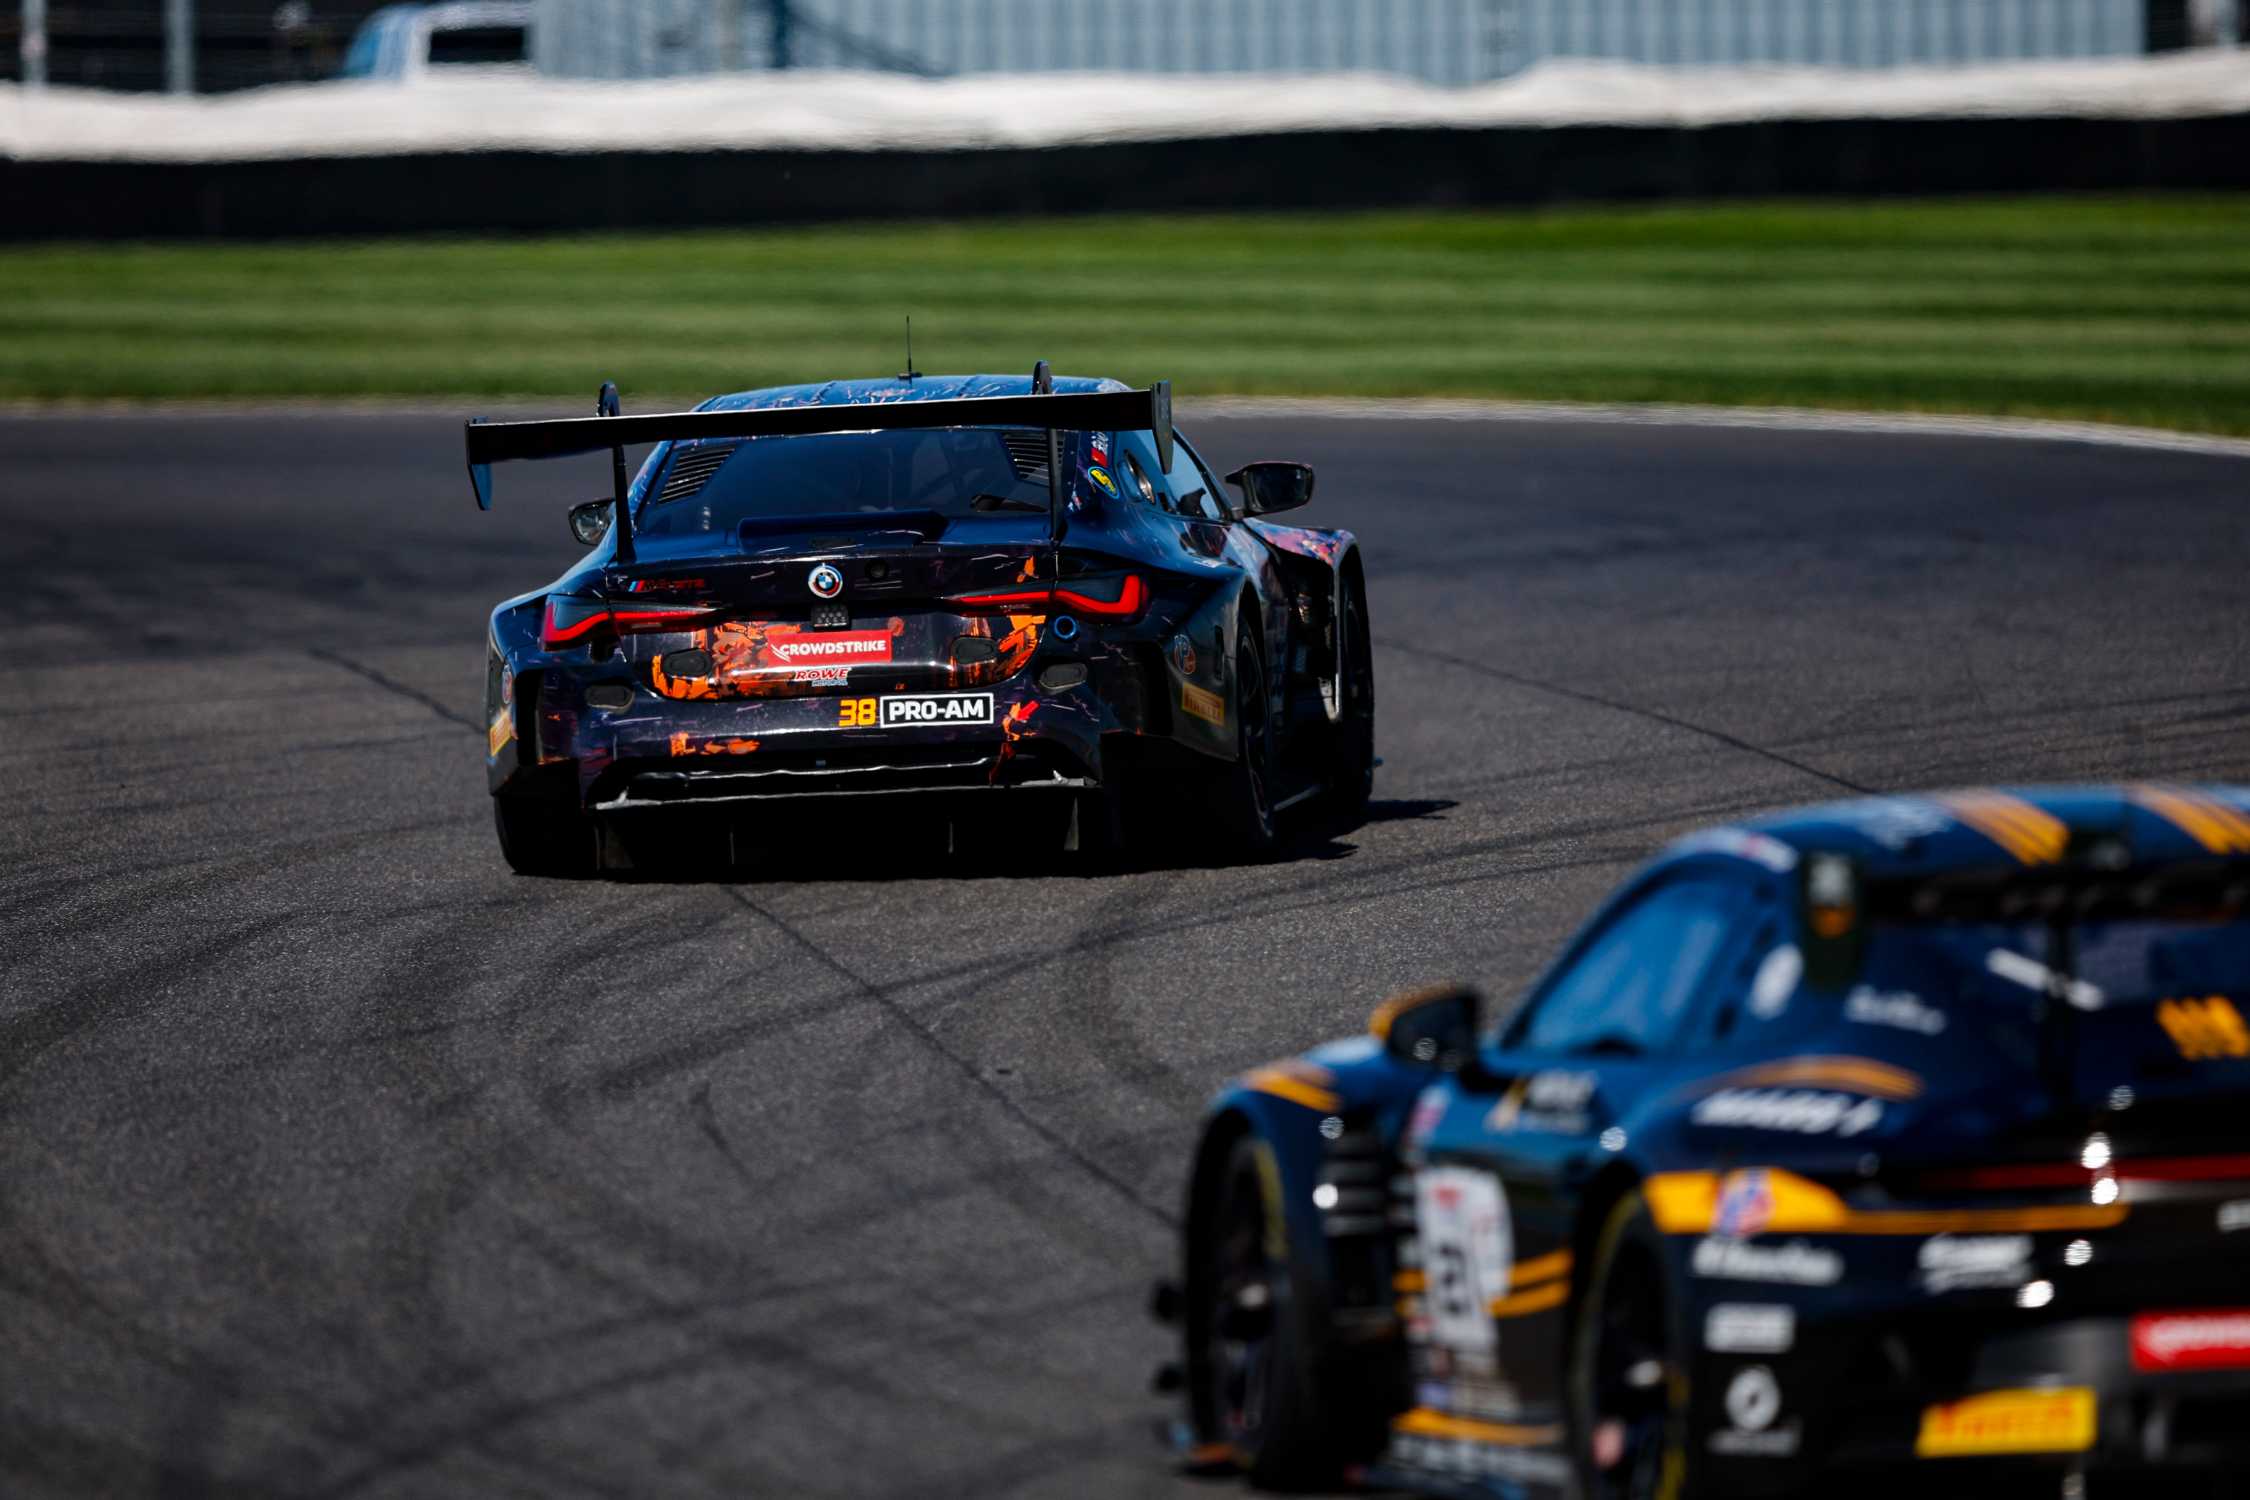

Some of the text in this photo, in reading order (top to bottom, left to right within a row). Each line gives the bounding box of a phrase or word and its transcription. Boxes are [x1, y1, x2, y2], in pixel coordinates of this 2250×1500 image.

[779, 640, 886, 656] CROWDSTRIKE
[795, 668, 849, 680] ROWE
[838, 698, 984, 727] 38 PRO-AM
